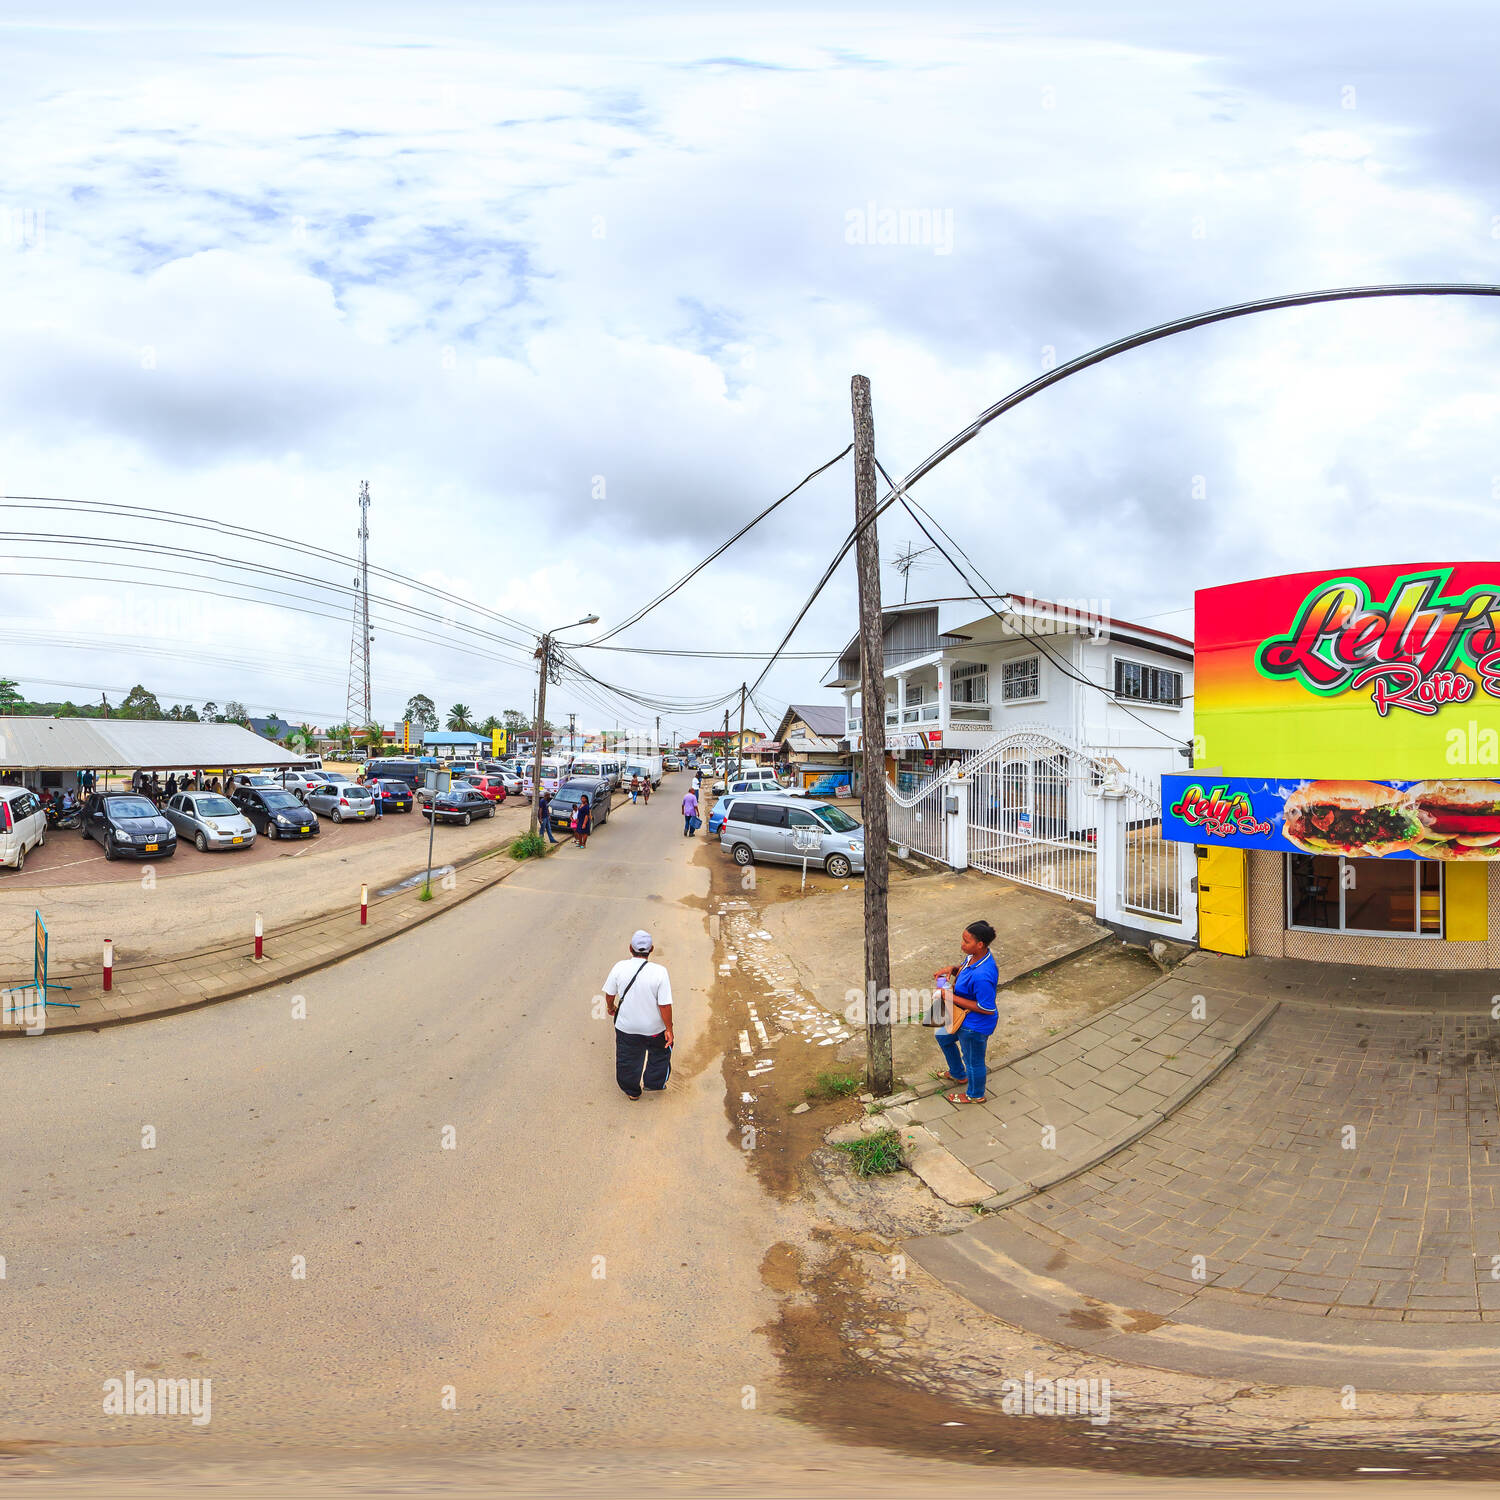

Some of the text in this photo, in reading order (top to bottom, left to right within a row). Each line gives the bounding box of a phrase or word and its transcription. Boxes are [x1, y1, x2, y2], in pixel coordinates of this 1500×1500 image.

[1352, 661, 1475, 716] Rotie
[1170, 784, 1252, 826] Lely's
[1237, 816, 1271, 834] Shop
